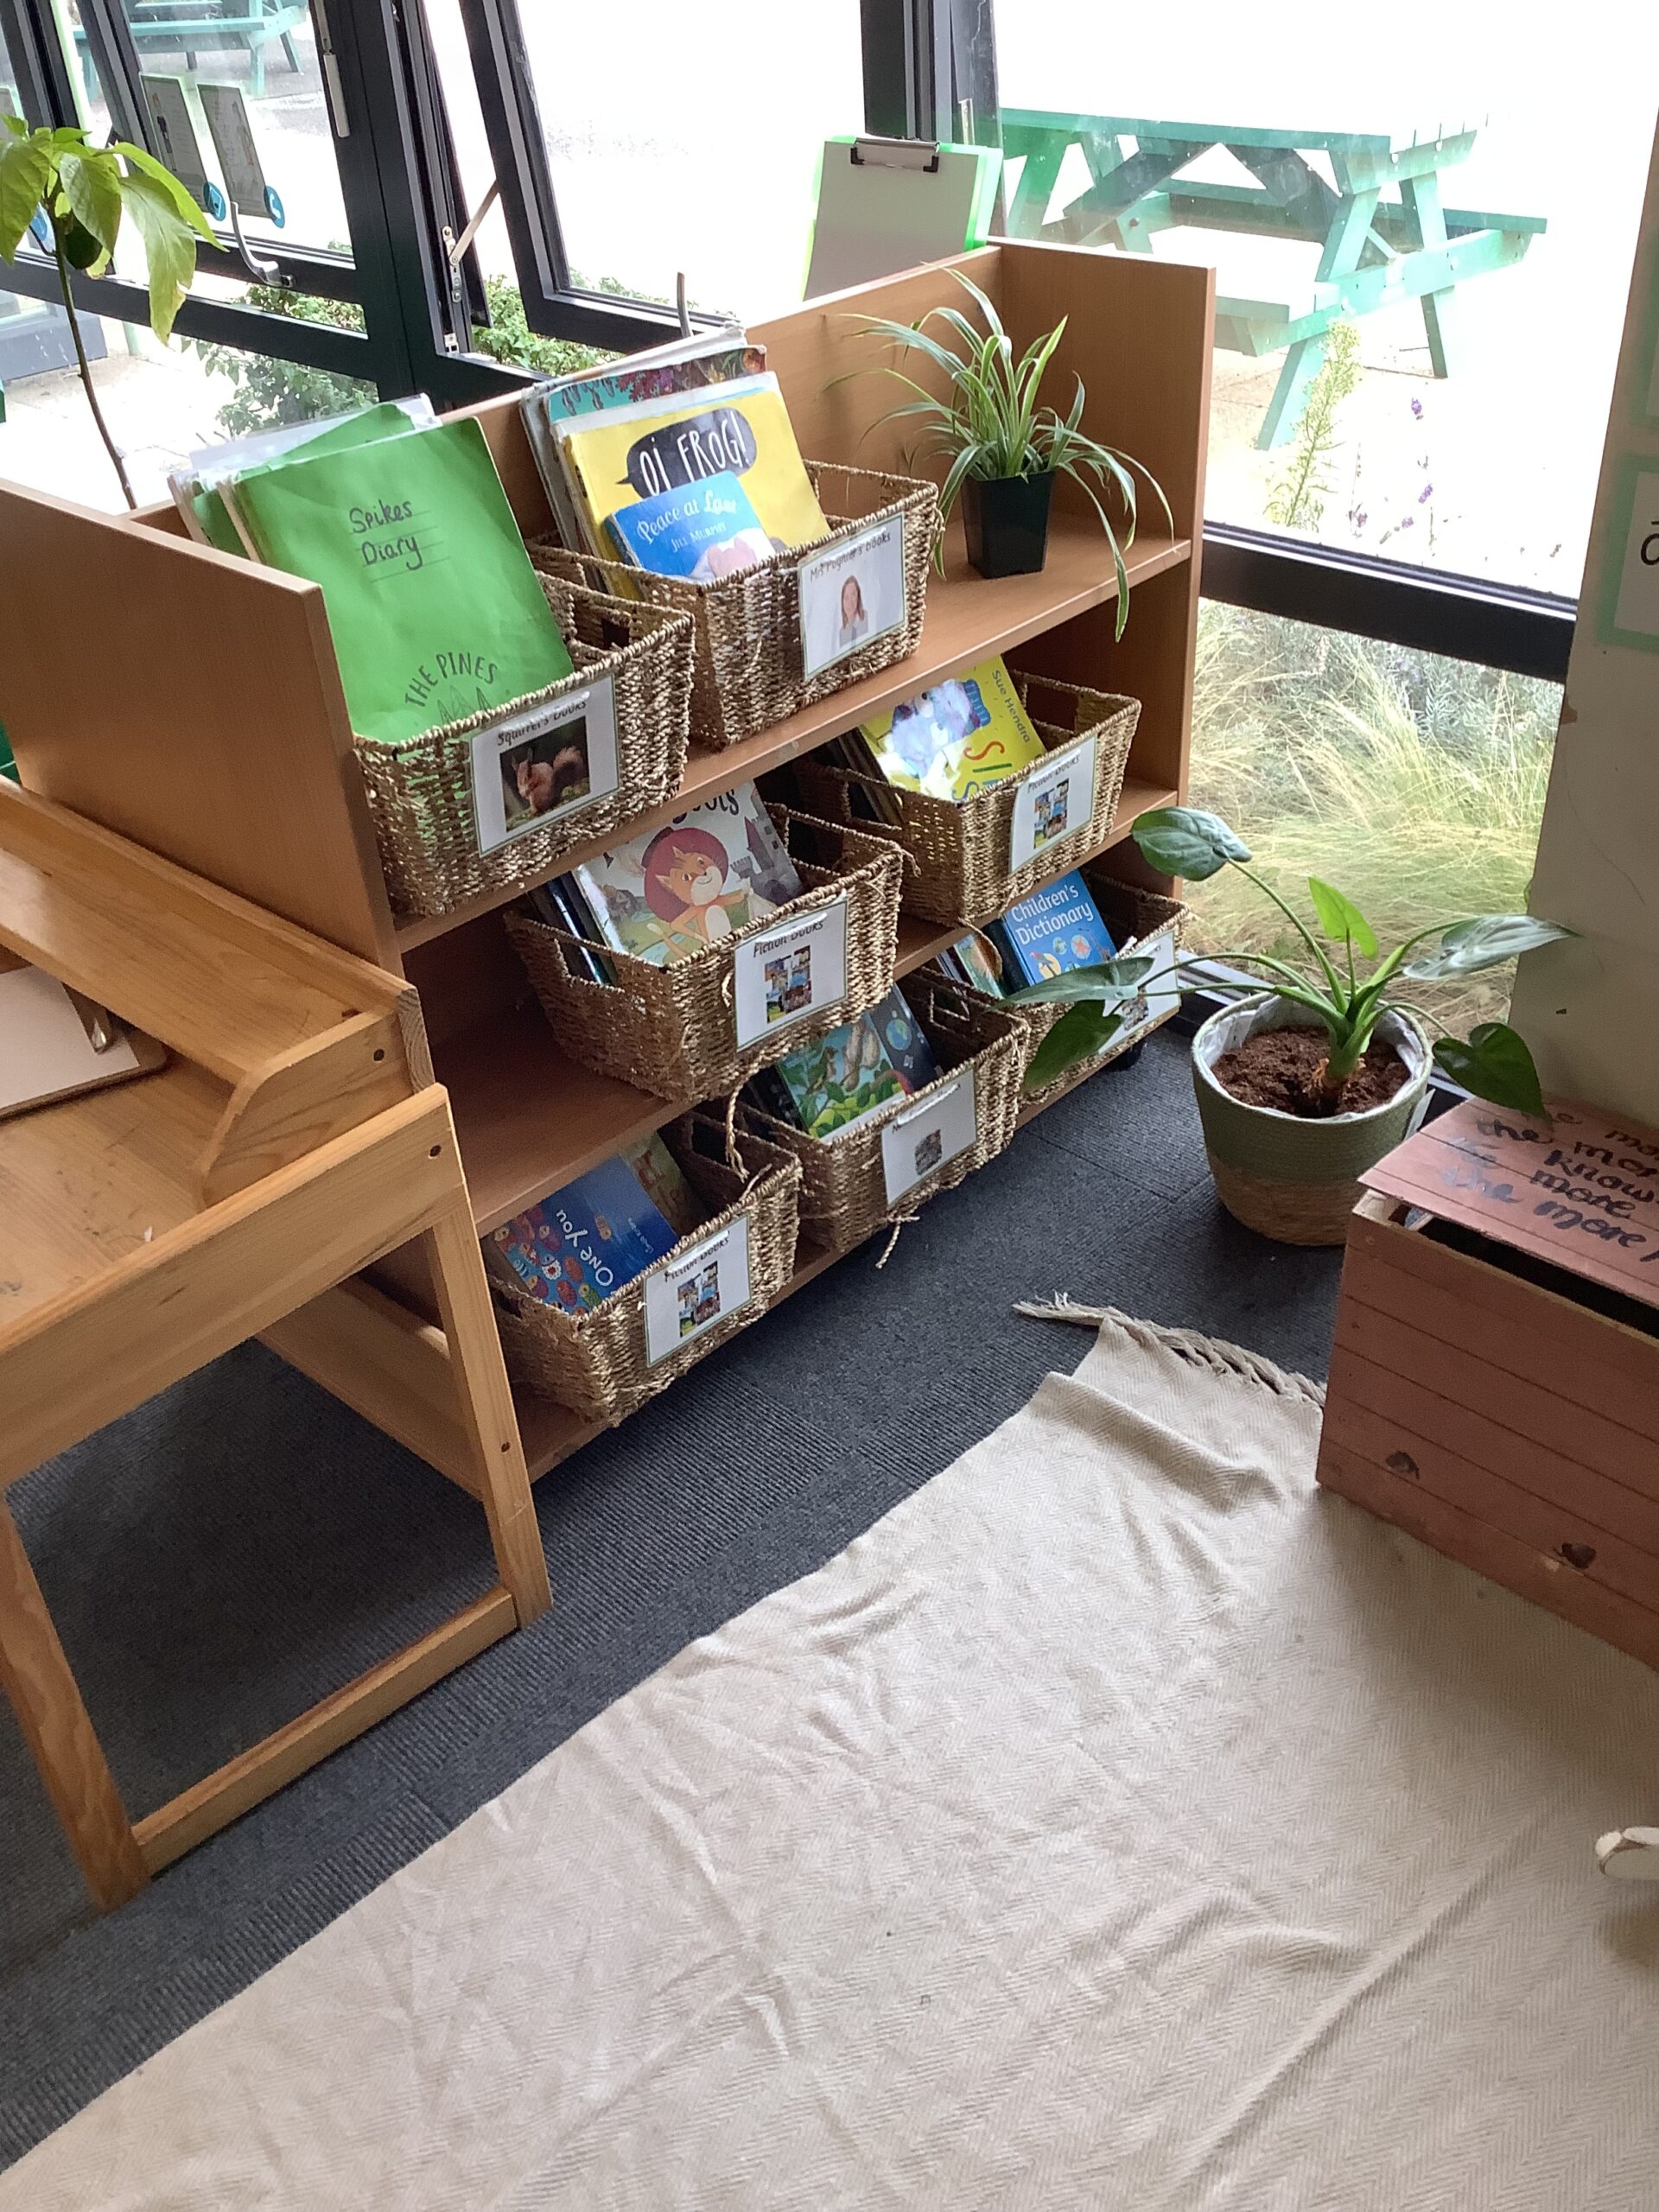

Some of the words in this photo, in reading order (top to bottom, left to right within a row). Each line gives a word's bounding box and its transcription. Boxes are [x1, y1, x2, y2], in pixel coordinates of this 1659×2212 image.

[349, 499, 412, 534] Spikes
[636, 506, 681, 545] Peace
[683, 501, 700, 516] at
[361, 536, 423, 571] Diary
[404, 665, 439, 709] THE
[435, 652, 498, 684] PINES
[991, 670, 1007, 696] Sue
[1004, 696, 1032, 744] Hendra
[1011, 884, 1079, 923] Children's
[1015, 902, 1094, 946] Dictionary
[1530, 1169, 1637, 1219] more
[556, 1210, 588, 1247] You
[1533, 1200, 1648, 1248] more
[580, 1246, 614, 1287] One
